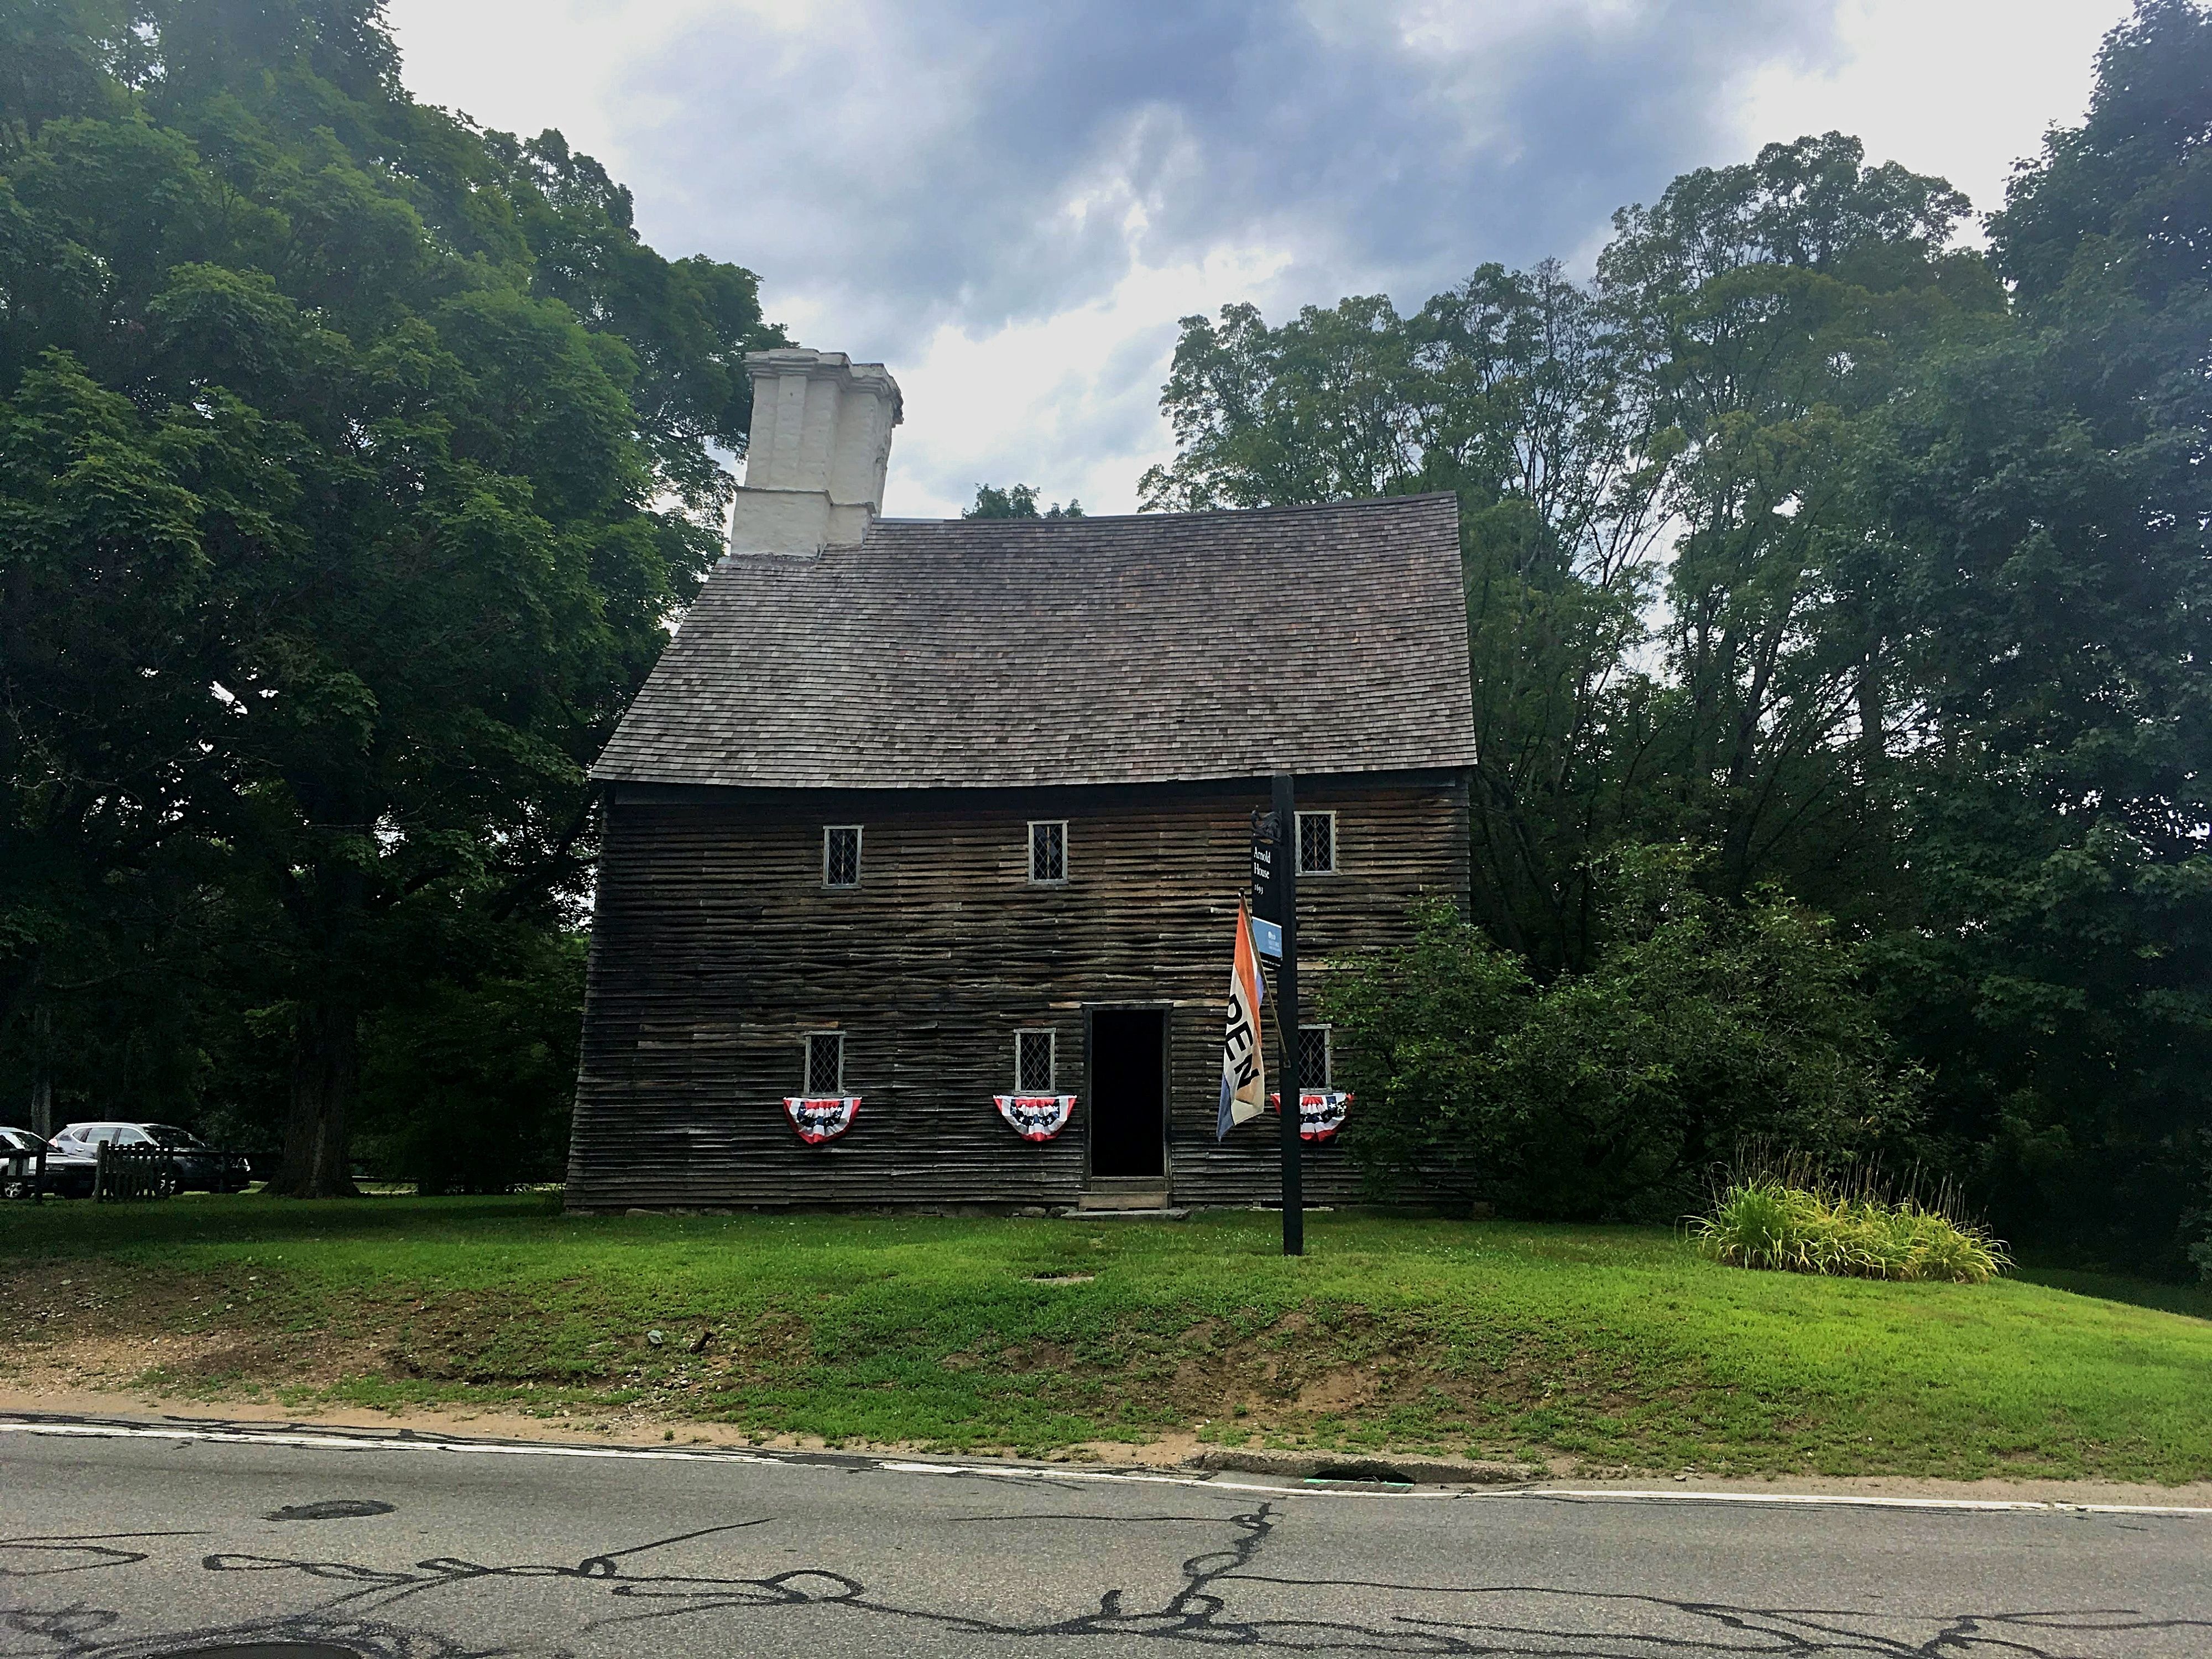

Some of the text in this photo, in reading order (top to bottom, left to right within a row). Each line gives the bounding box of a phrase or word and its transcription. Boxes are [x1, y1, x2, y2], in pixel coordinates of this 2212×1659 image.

[1254, 846, 1271, 864] Arnold
[1254, 862, 1270, 879] House
[1254, 884, 1264, 895] 1693
[1225, 993, 1260, 1091] PEN
